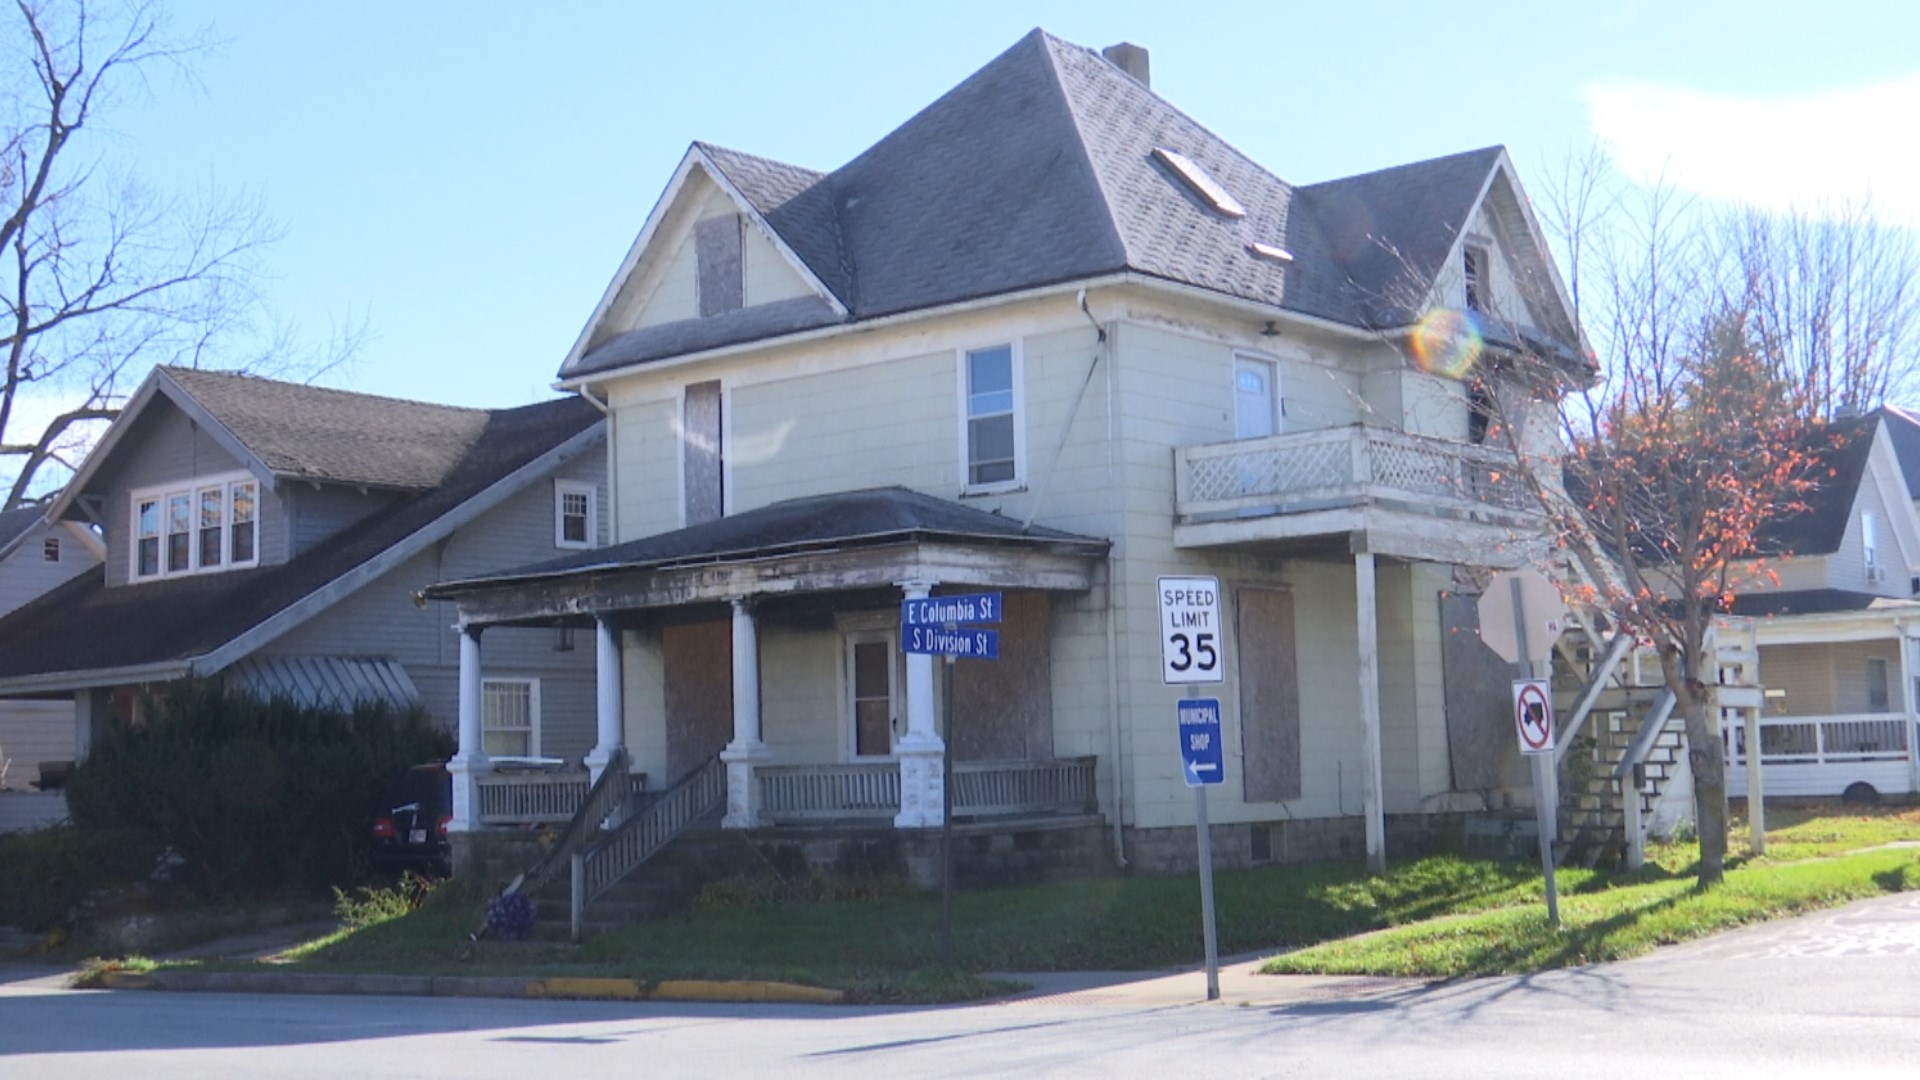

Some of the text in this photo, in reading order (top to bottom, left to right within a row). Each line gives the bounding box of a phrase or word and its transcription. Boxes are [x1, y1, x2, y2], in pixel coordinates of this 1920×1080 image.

[1164, 590, 1214, 606] SPEED
[909, 597, 992, 624] E Columbia St
[1171, 611, 1209, 628] LIMIT
[913, 627, 988, 655] S Division St
[1170, 633, 1217, 672] 35
[1180, 707, 1218, 725] MUNICIPAL
[1190, 733, 1210, 751] SHOP
